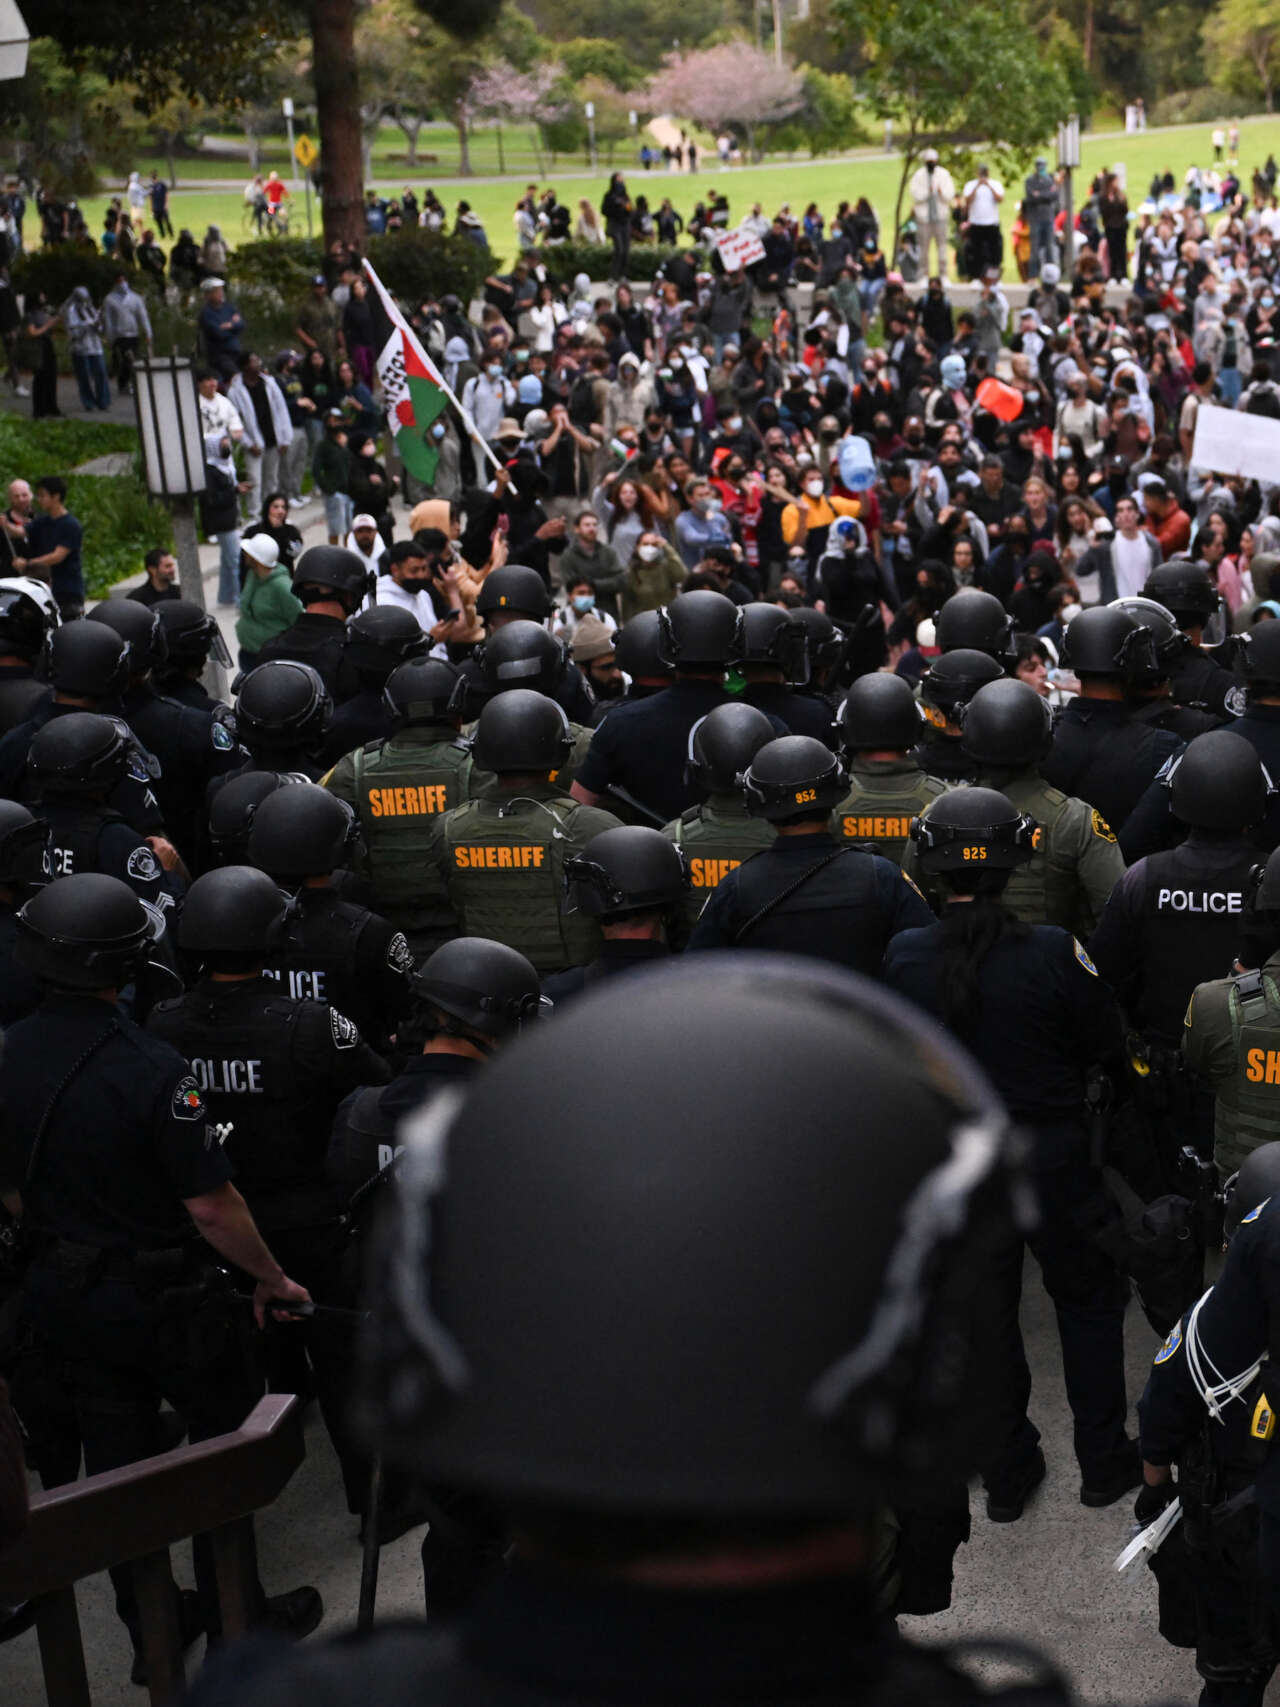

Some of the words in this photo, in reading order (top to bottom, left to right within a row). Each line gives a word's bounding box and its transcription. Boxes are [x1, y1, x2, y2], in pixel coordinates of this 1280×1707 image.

[368, 784, 447, 817] SHERIFF
[794, 787, 817, 805] 952
[842, 816, 913, 838] SHERI
[454, 846, 545, 868] SHERIFF
[962, 846, 988, 861] 925
[1157, 888, 1243, 913] POLICE
[184, 1057, 265, 1094] OLICE
